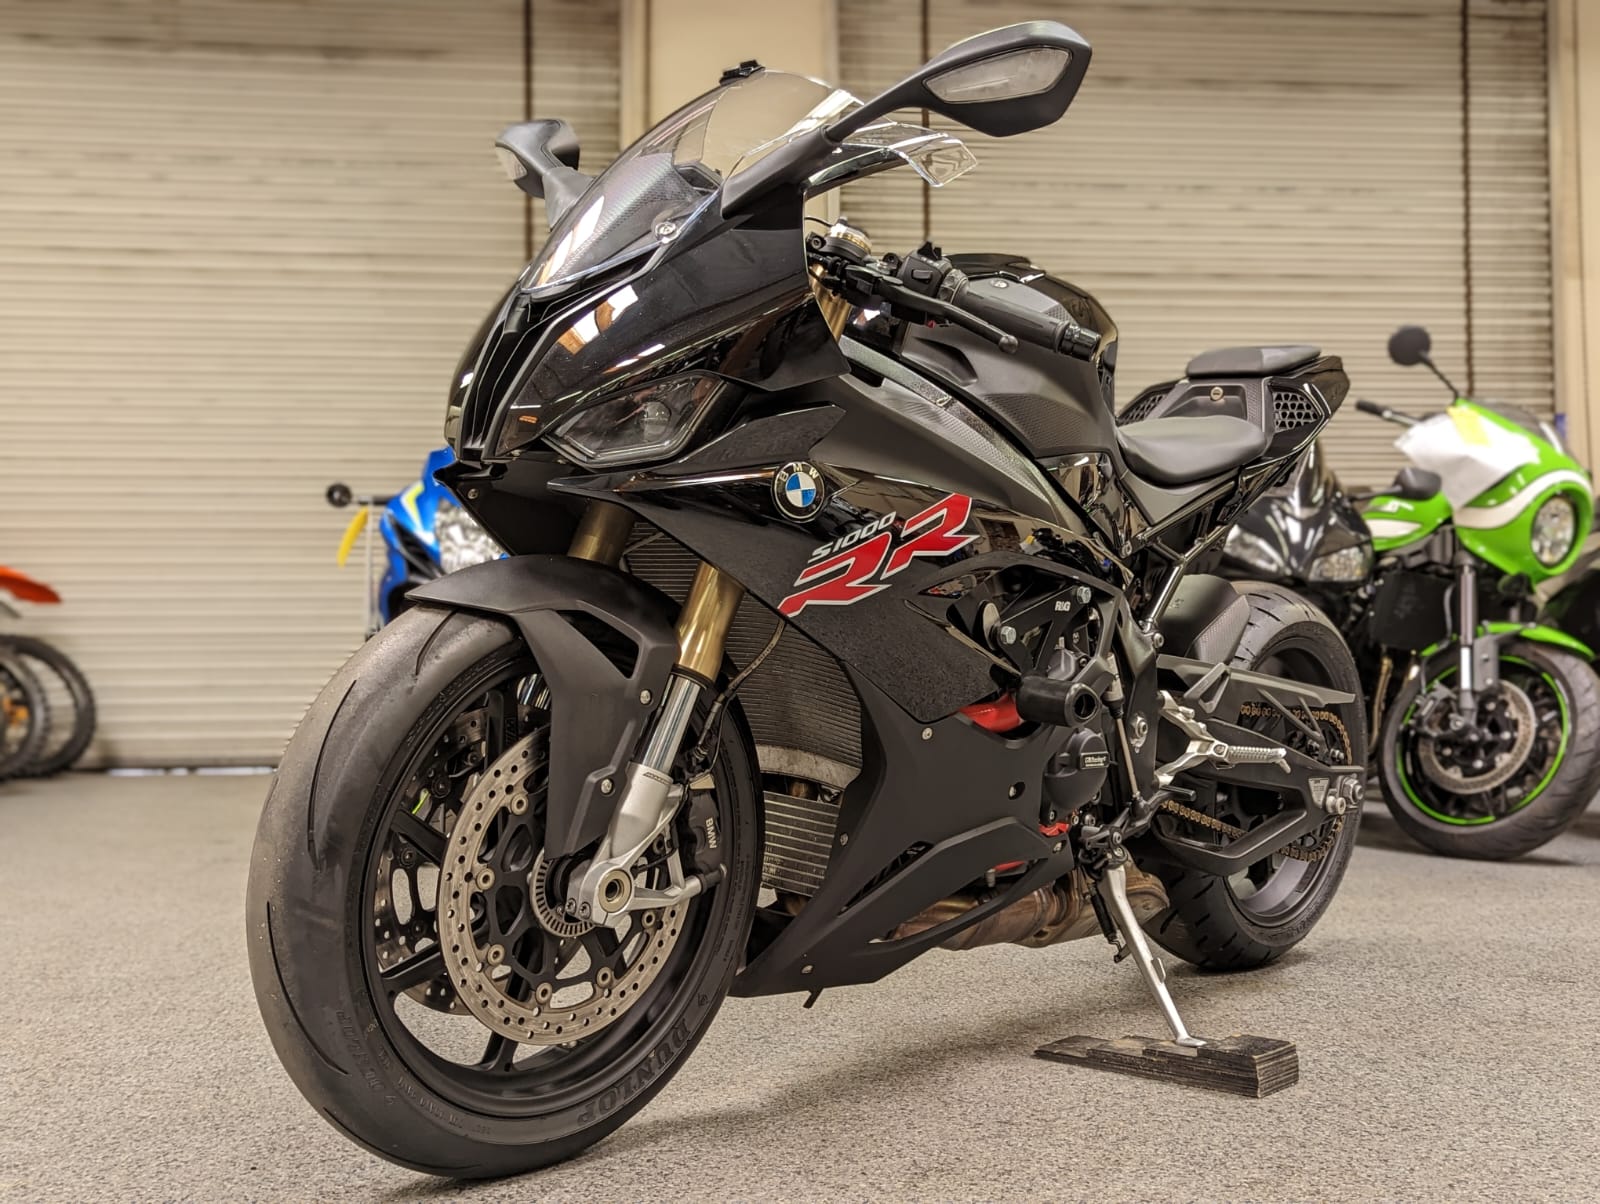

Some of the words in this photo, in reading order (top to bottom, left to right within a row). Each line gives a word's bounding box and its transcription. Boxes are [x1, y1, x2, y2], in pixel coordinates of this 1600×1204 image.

[779, 463, 819, 482] BMW
[777, 493, 980, 617] RR
[808, 511, 896, 563] S1000
[705, 818, 718, 849] BMW
[577, 1018, 691, 1127] DUNLOP
